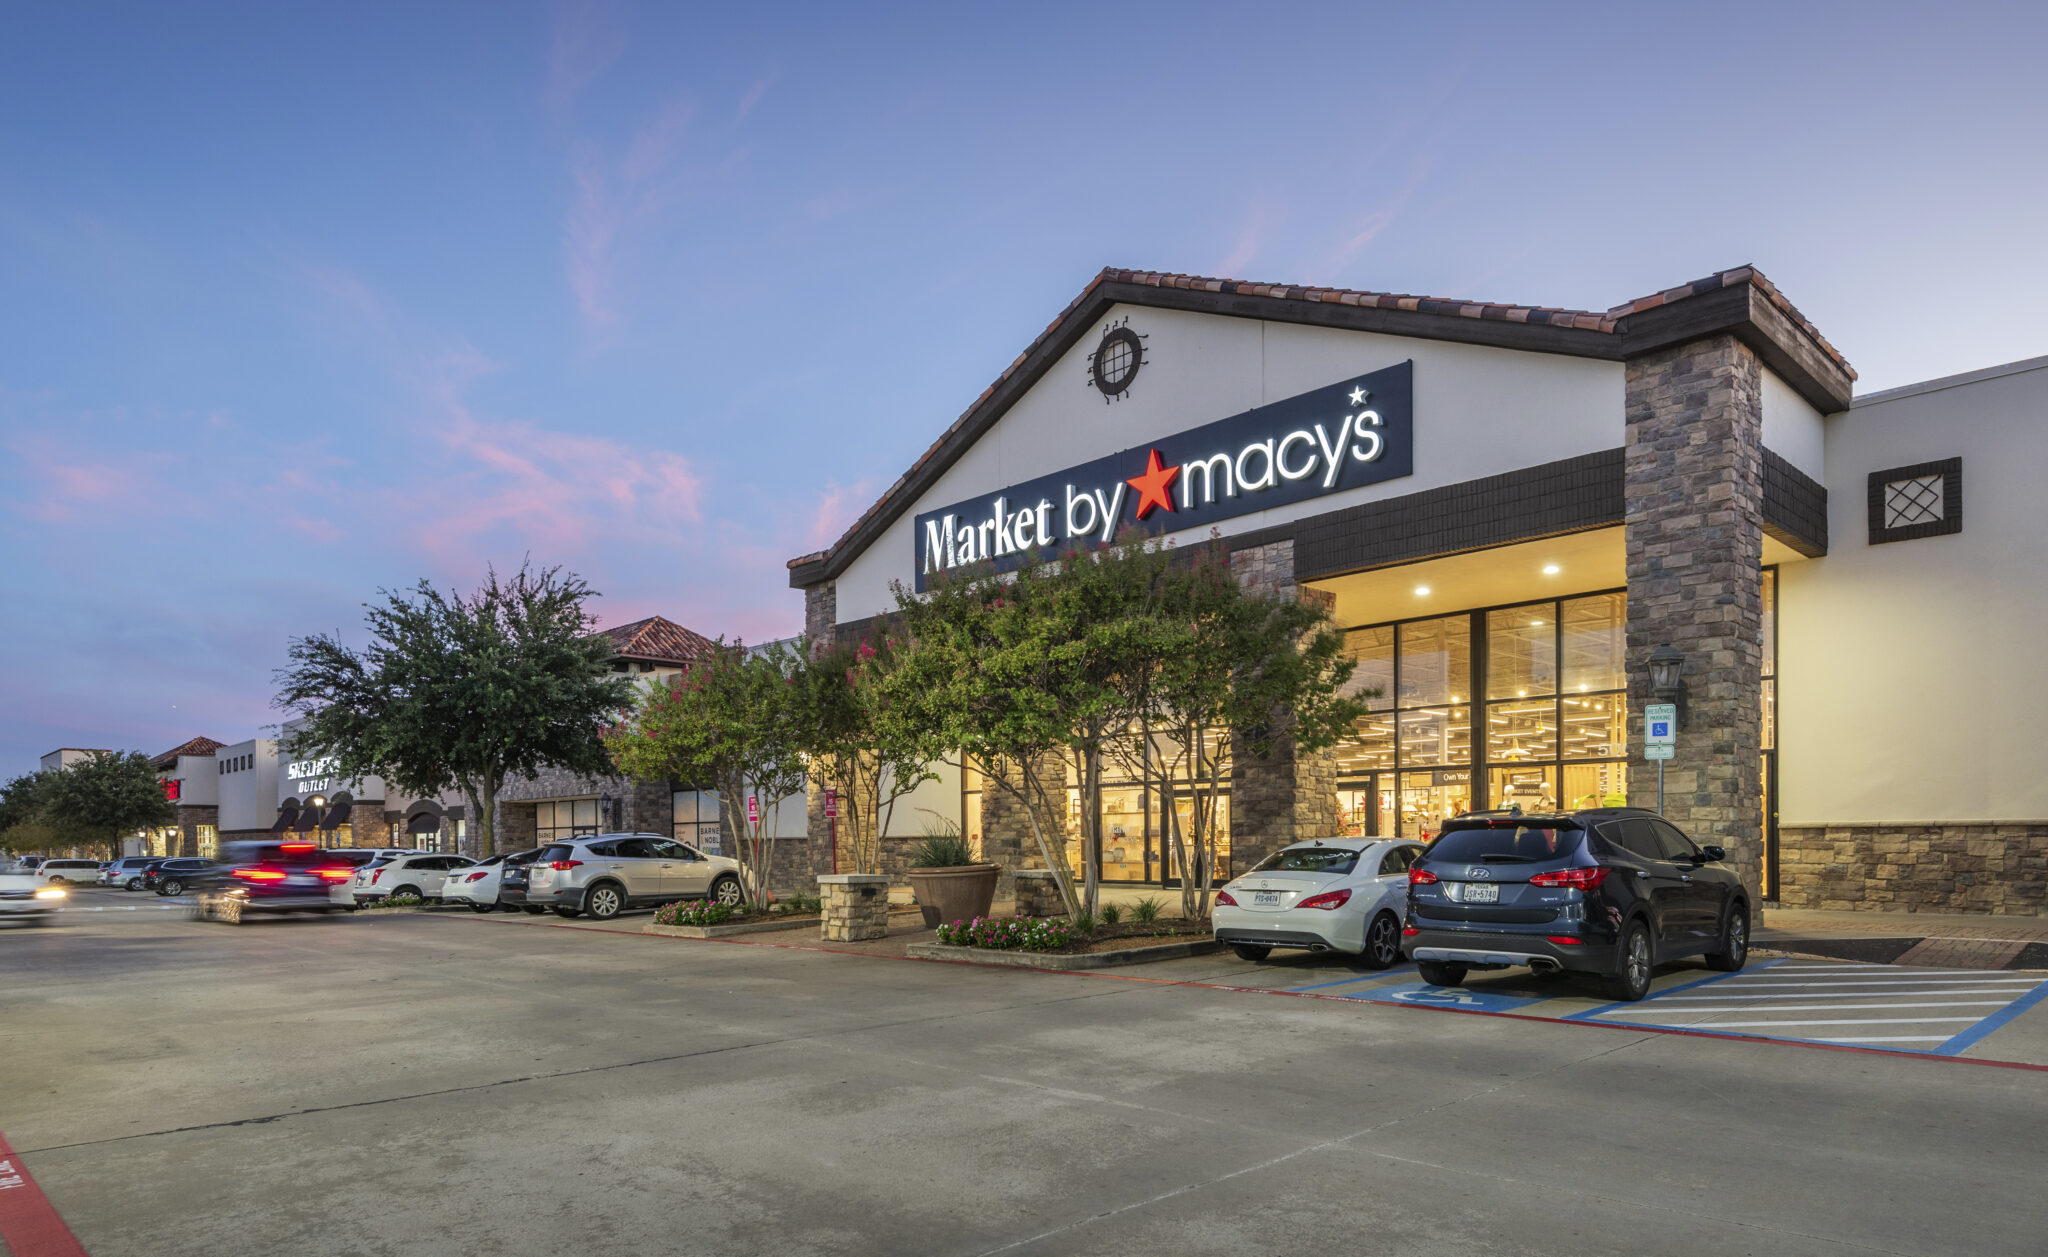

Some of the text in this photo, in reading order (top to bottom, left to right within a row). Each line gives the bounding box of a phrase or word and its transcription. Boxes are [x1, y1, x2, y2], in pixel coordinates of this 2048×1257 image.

[923, 497, 1055, 575] Market
[1066, 481, 1127, 543] by
[1457, 772, 1469, 780] Your
[298, 779, 330, 793] OUTLET
[700, 827, 720, 835] BARNE
[704, 836, 720, 844] NOBL
